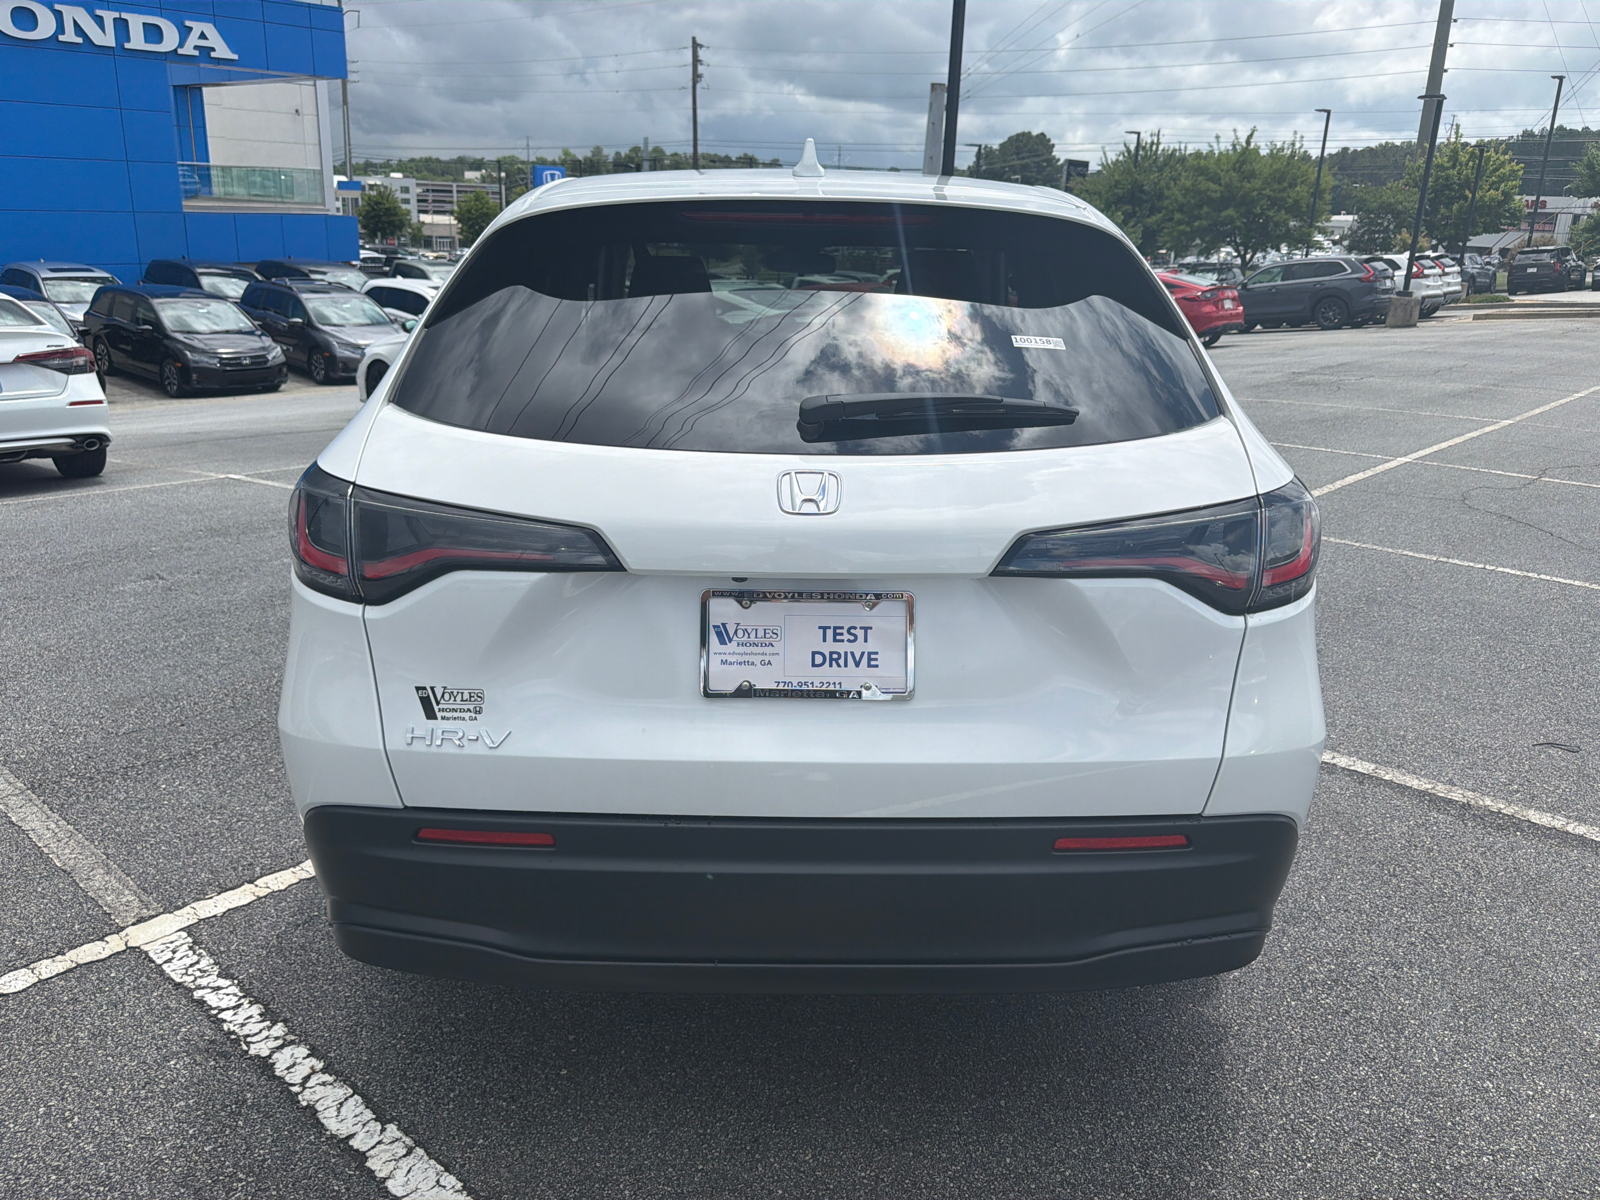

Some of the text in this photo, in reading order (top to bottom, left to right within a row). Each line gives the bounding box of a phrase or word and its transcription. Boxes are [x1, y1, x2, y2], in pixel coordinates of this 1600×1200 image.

[720, 622, 779, 644] VOYLES
[818, 625, 873, 643] TEST
[720, 659, 773, 667] Marietta, GA
[811, 651, 879, 669] DRIVE
[774, 681, 842, 689] 770-951-2211
[429, 686, 483, 706] VOYLES
[406, 727, 512, 749] HR-V
